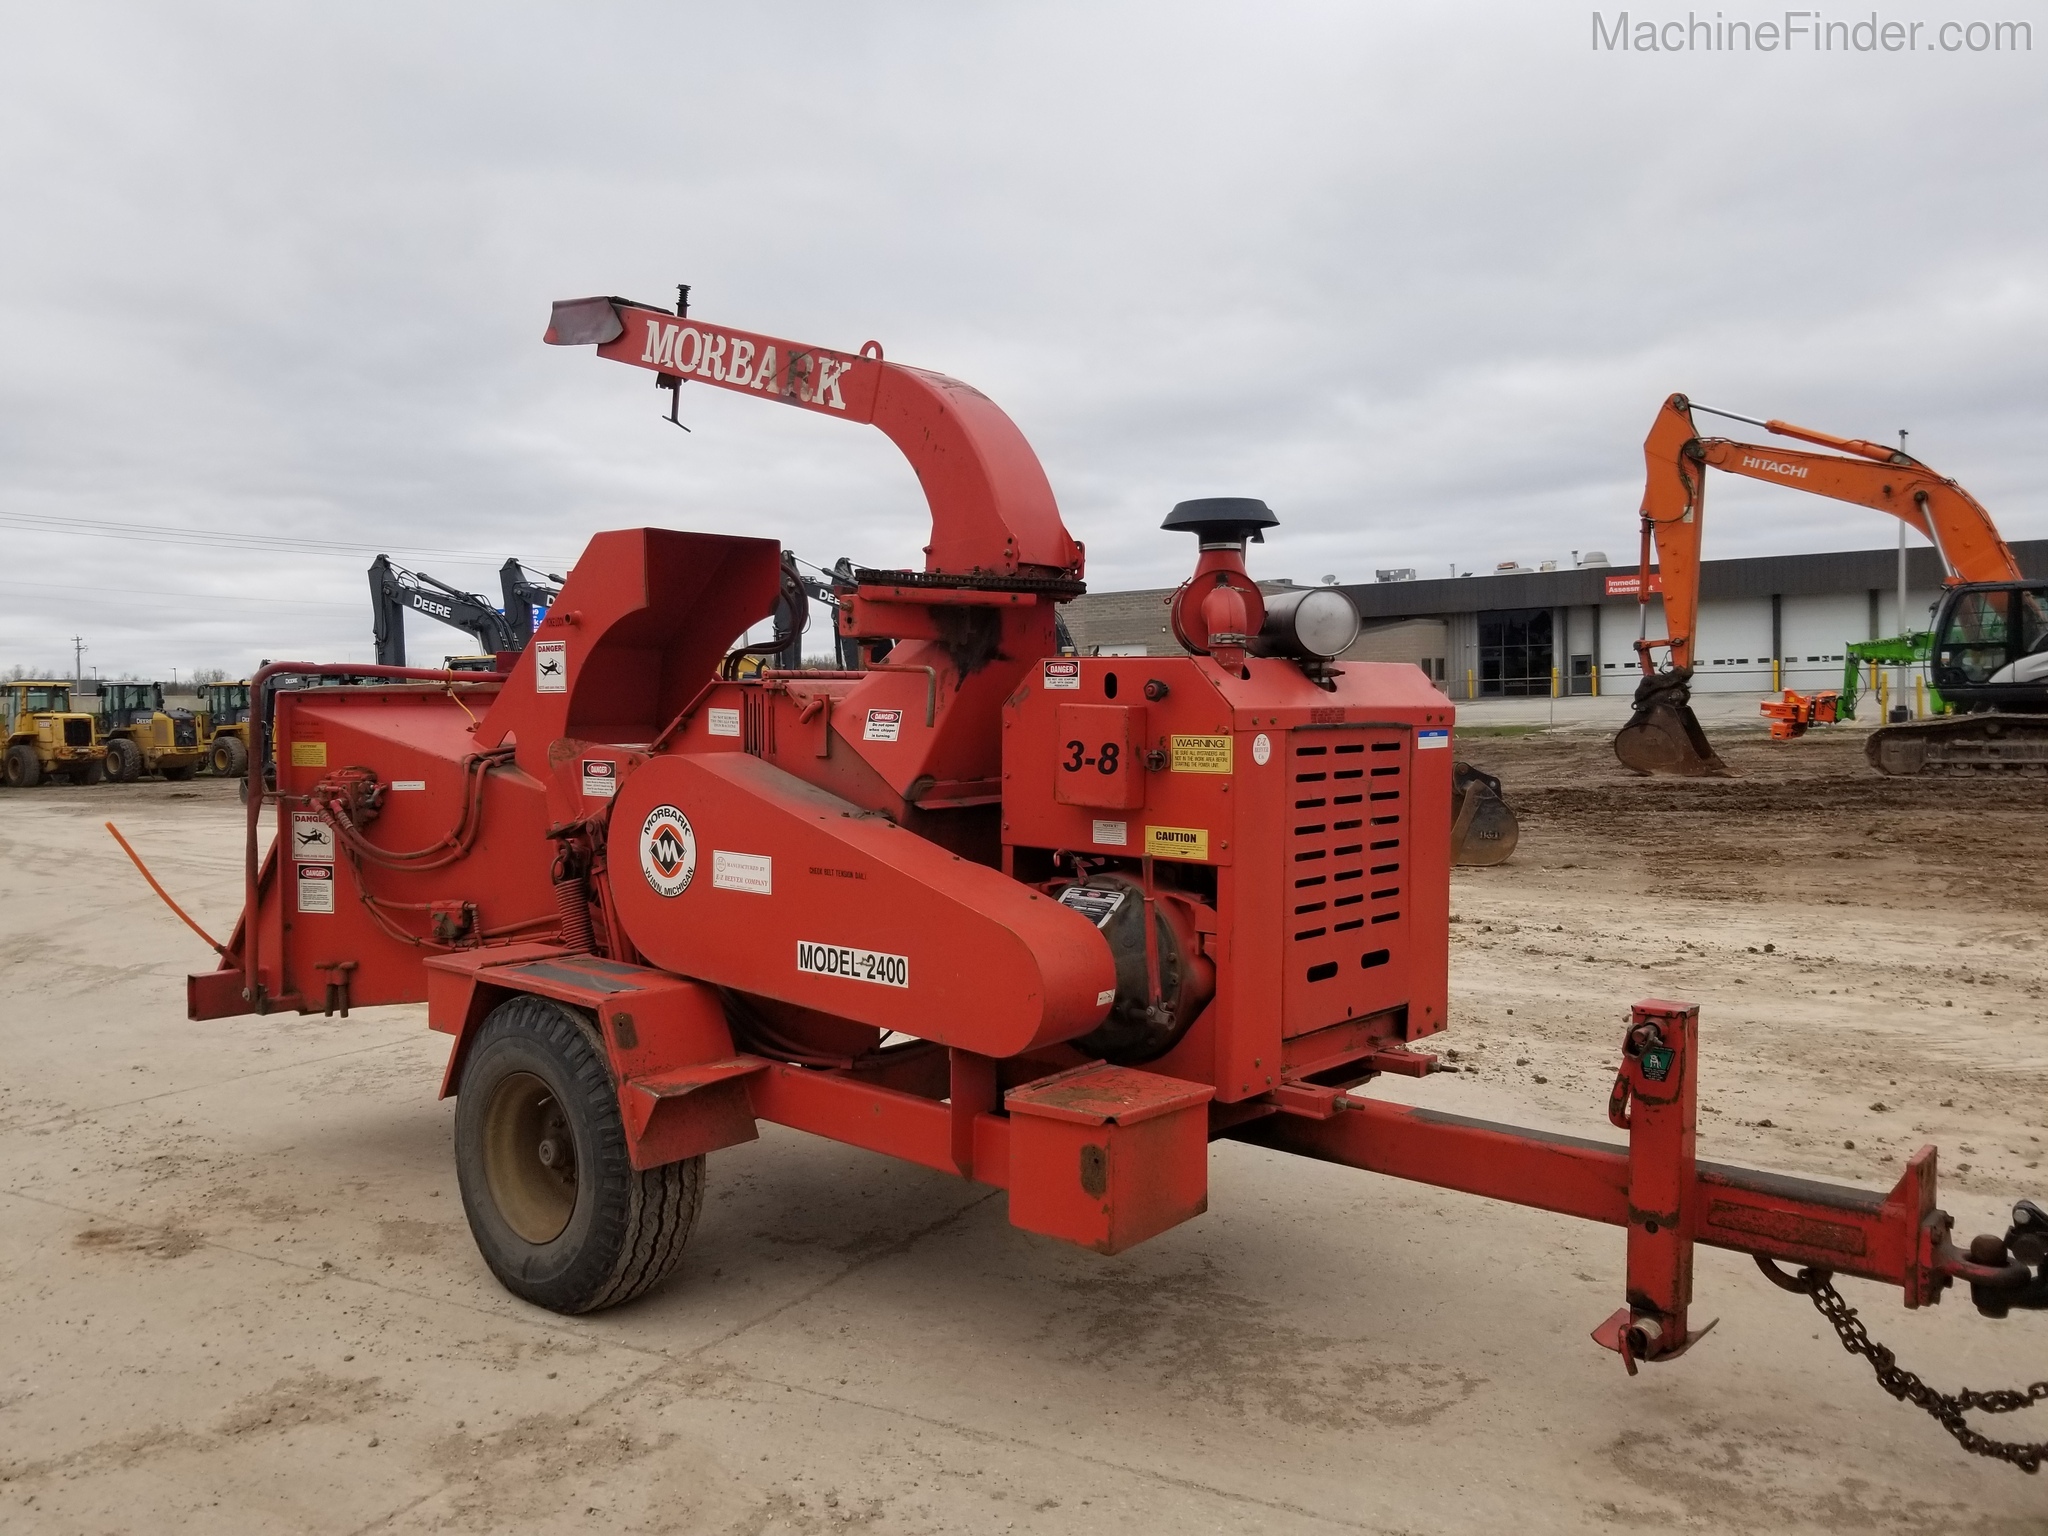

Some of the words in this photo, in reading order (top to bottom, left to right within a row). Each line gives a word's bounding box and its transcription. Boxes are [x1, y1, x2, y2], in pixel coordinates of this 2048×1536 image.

[641, 319, 852, 410] MORBARK
[1742, 455, 1808, 479] HITACHI
[413, 594, 452, 619] DEERE
[1050, 665, 1073, 674] DANGER
[1175, 738, 1226, 748] WARNING!
[1063, 741, 1120, 775] 3-8
[643, 807, 692, 836] MORBARK
[1155, 830, 1197, 843] CAUTION
[305, 869, 326, 877] DANGER
[663, 866, 694, 896] MICHIGAN
[744, 877, 768, 886] COMPANY
[799, 943, 861, 978] MODEL
